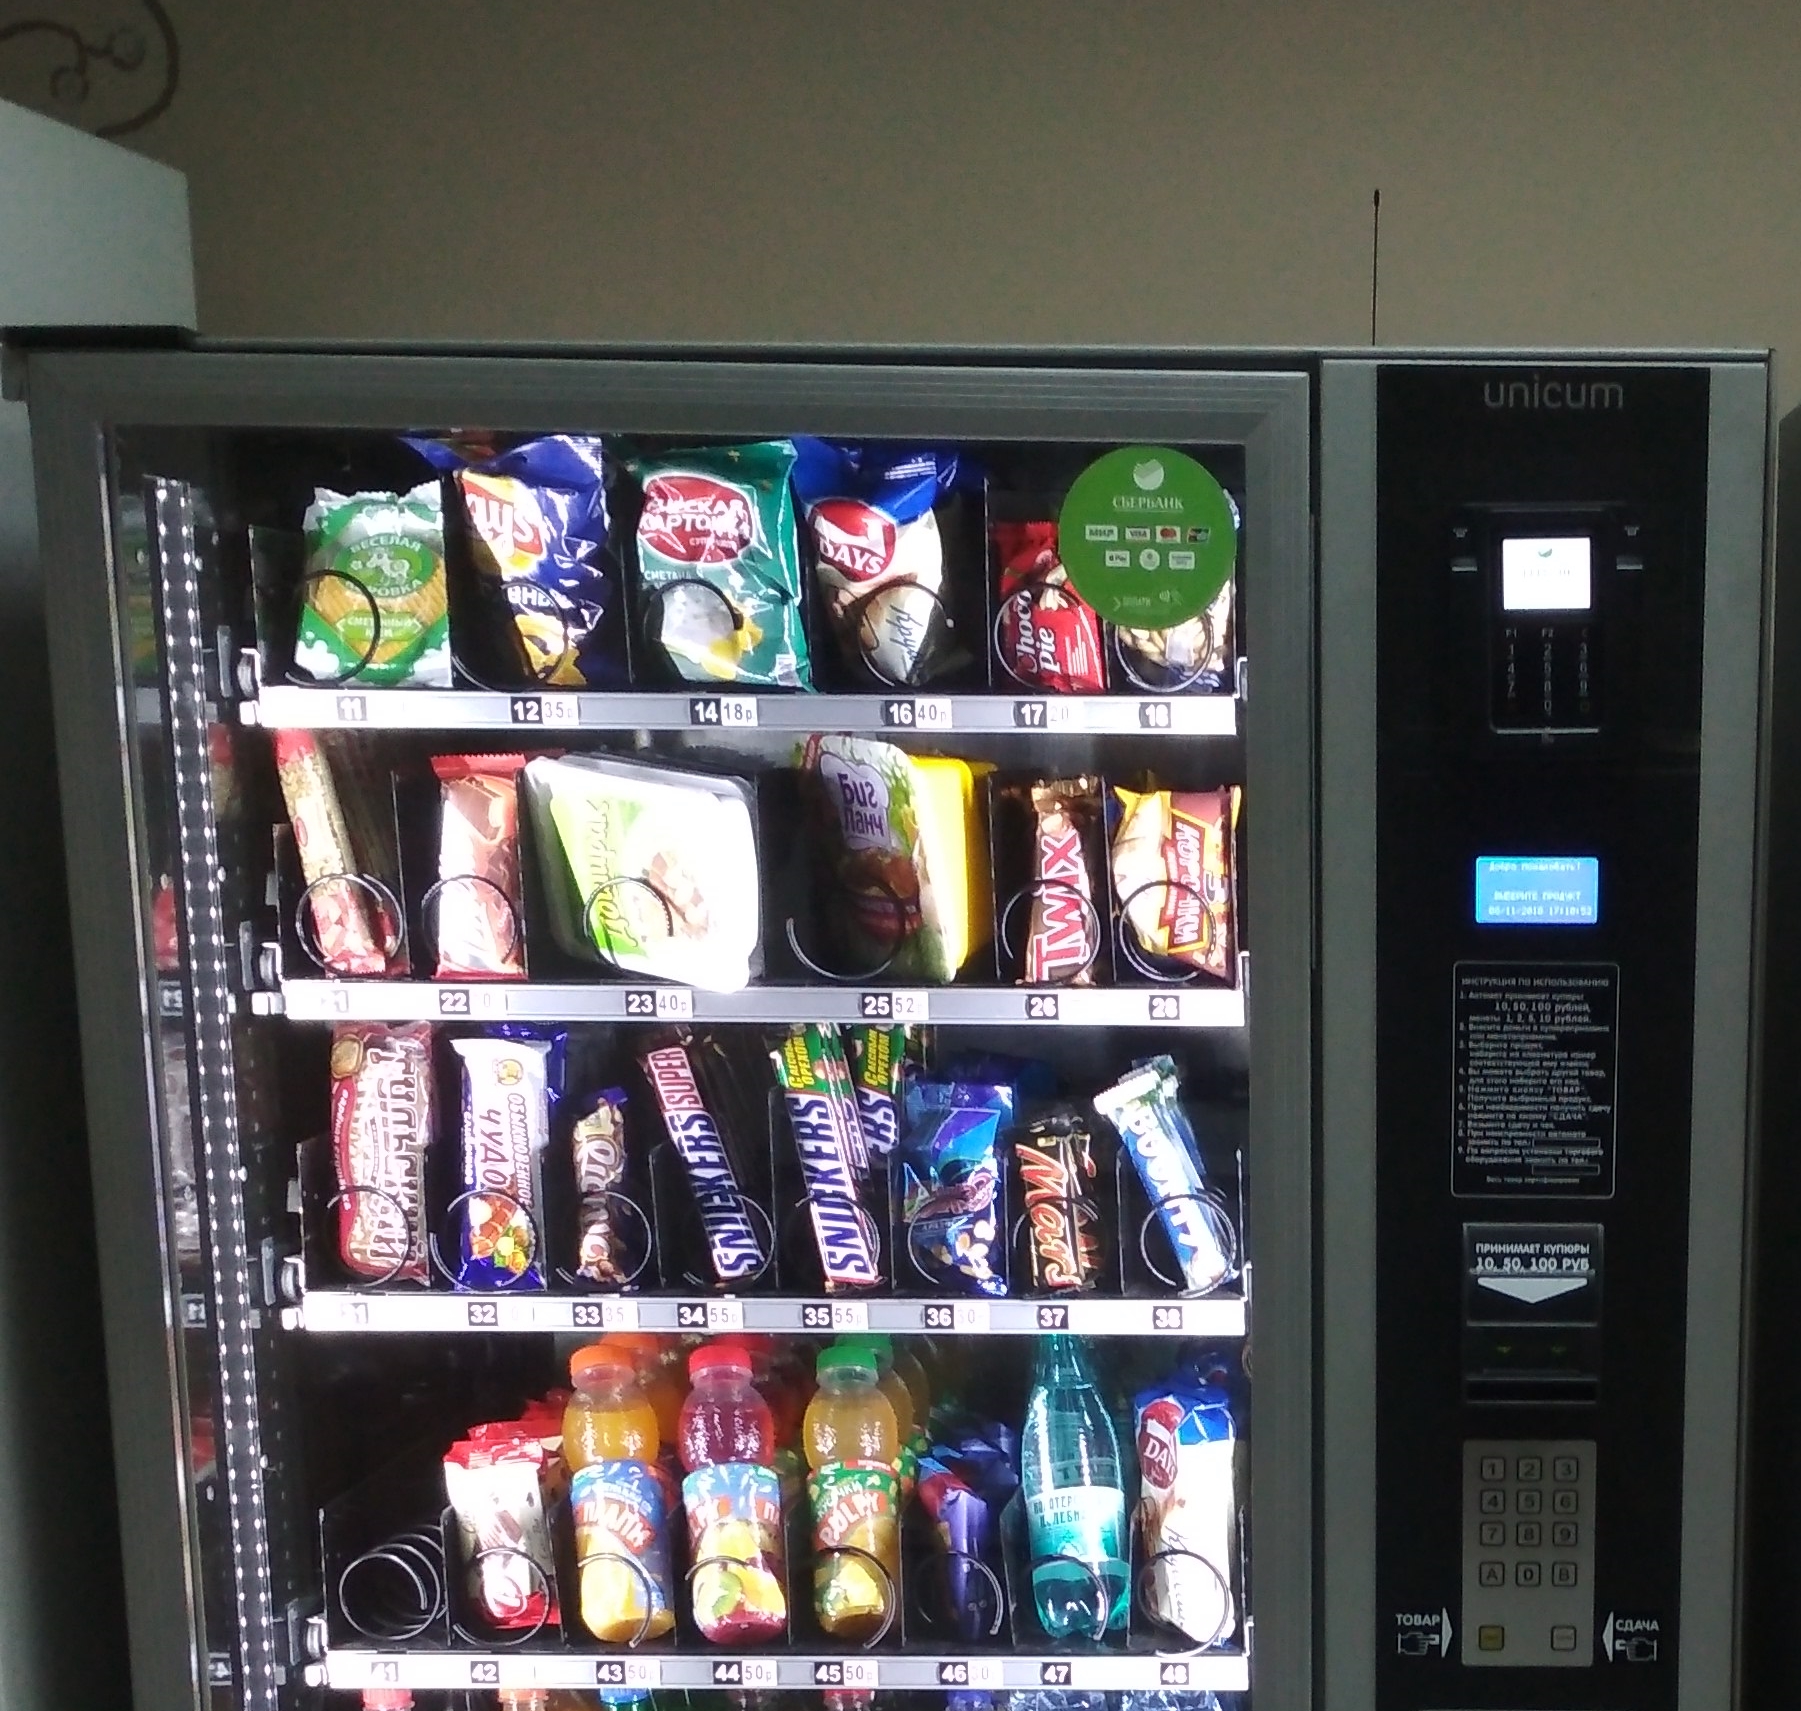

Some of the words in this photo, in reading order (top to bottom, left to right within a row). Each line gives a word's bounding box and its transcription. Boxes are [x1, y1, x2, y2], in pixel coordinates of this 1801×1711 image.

[1483, 373, 1624, 409] unicum
[1112, 496, 1184, 511] СБЕРБАНК
[350, 535, 422, 553] ВЕСЕЛАЯ
[1036, 627, 1062, 675] pie
[340, 698, 362, 720] 11
[513, 701, 540, 722] 12
[695, 702, 718, 722] 14
[889, 704, 913, 725] 16
[1022, 705, 1044, 727] 17
[1146, 704, 1169, 727] 18
[1033, 829, 1090, 982] TWIX
[442, 992, 467, 1012] 22
[629, 994, 654, 1014] 23
[864, 997, 890, 1016] 25
[1031, 998, 1056, 1018] 26
[1152, 998, 1178, 1018] 28
[648, 1046, 703, 1113] SUPER
[479, 1108, 510, 1188] ЧУДО
[1015, 1143, 1082, 1291] Mars
[1475, 1243, 1541, 1254] ПРИНИМАЕТ
[1544, 1243, 1591, 1255] КУПЮРЫ
[1475, 1257, 1499, 1272] 10,
[1502, 1257, 1526, 1273] 50,
[1530, 1257, 1558, 1271] 100
[1562, 1258, 1590, 1271] РУБ
[470, 1305, 496, 1323] 32
[575, 1306, 600, 1325] 33
[680, 1307, 705, 1325] 34
[805, 1307, 830, 1326] 35
[927, 1307, 952, 1327] 36
[1041, 1307, 1065, 1327] 37
[1156, 1309, 1181, 1328] 38
[1489, 1463, 1497, 1476] 1
[1523, 1463, 1536, 1476] 2
[1561, 1463, 1572, 1476] 3
[1487, 1496, 1499, 1508] 4
[1523, 1496, 1535, 1508] 5
[1560, 1496, 1571, 1508] 6
[1488, 1528, 1499, 1541] 7
[1523, 1528, 1535, 1541] 8
[1559, 1528, 1571, 1541] 9
[1395, 1613, 1442, 1627] ТОВАР
[1615, 1619, 1660, 1632] СДАЧА
[373, 1663, 397, 1681] 41
[472, 1664, 497, 1682] 42
[598, 1664, 623, 1682] 43
[715, 1664, 740, 1682] 44
[817, 1665, 841, 1683] 45
[941, 1665, 967, 1684] 46
[1044, 1665, 1069, 1684] 47
[1163, 1667, 1188, 1685] 48
